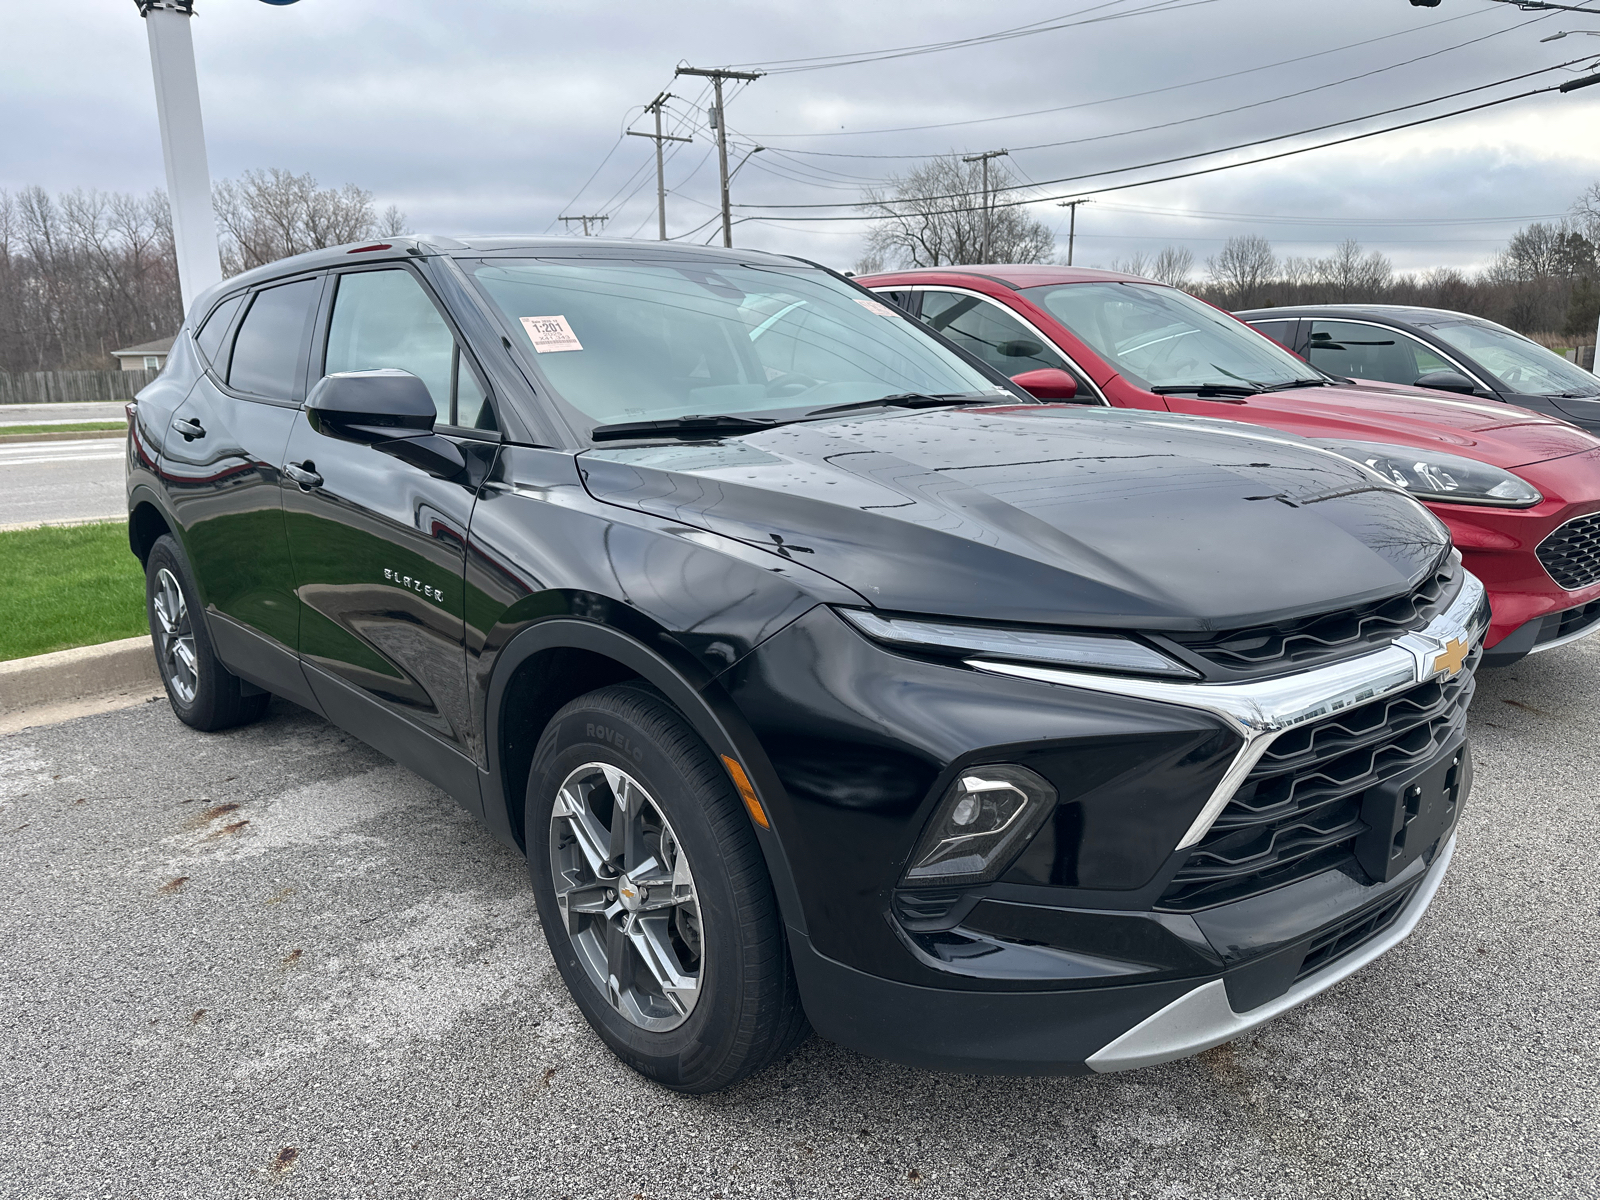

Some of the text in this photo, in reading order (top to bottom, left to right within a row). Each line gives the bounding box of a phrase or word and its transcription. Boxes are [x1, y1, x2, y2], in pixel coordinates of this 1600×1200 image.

[533, 322, 563, 333] 1:201
[383, 567, 444, 603] BLAZER
[586, 723, 643, 762] ROVELO
